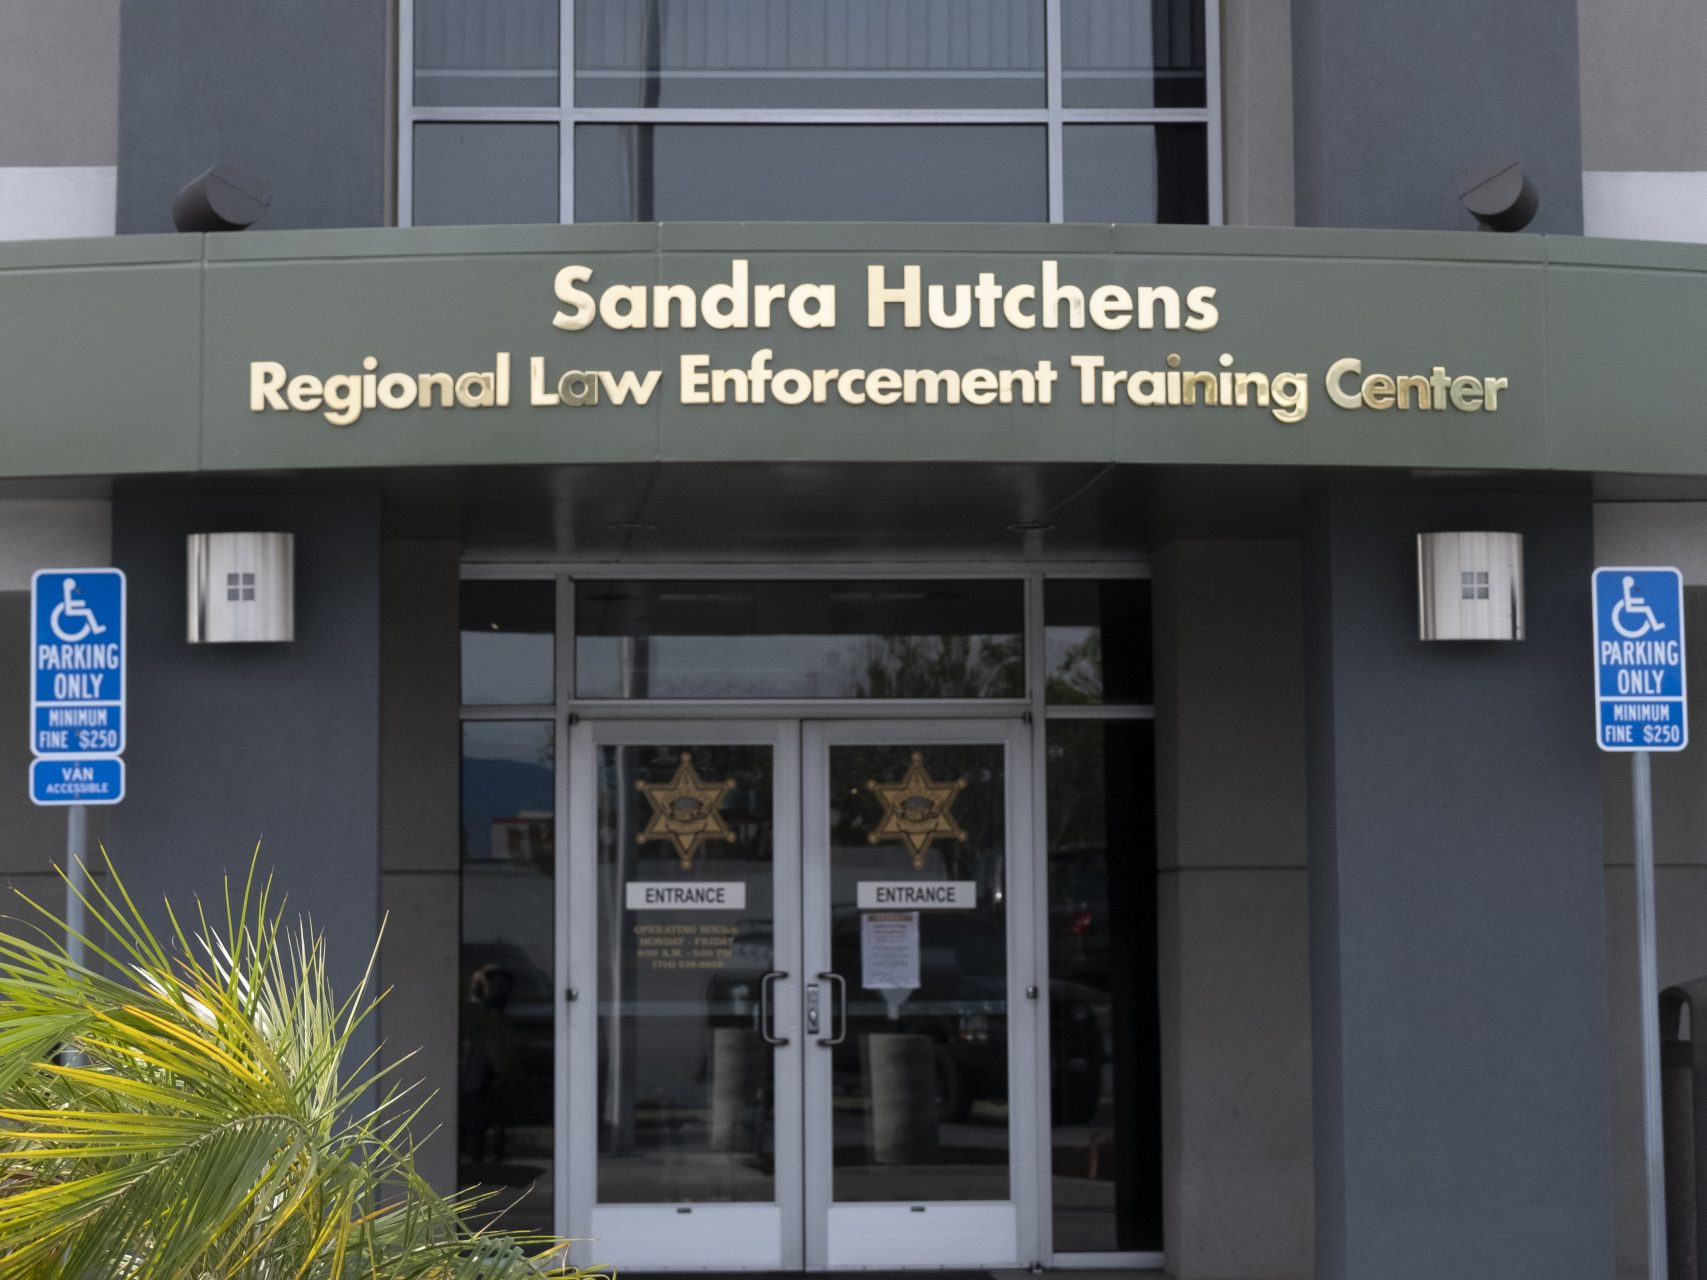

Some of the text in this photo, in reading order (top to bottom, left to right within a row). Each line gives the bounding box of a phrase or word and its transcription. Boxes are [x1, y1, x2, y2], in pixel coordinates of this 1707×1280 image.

[552, 259, 1219, 331] Sandra Hutchens
[250, 348, 1509, 427] Regional Law Enforcement Training Center
[38, 642, 120, 670] PARKING
[1601, 640, 1679, 666] PARKING
[53, 672, 104, 700] ONLY
[1617, 669, 1665, 695] ONLY
[49, 708, 108, 728] MINIMUM
[1613, 704, 1670, 722] MINIMUM
[39, 729, 118, 750] FINE $250
[1605, 724, 1680, 744] FINE $250
[61, 766, 94, 782] VAN
[46, 782, 110, 795] ACCESSIBLE
[645, 887, 725, 904] ENTRANCE
[876, 886, 956, 903] ENTRANCE
